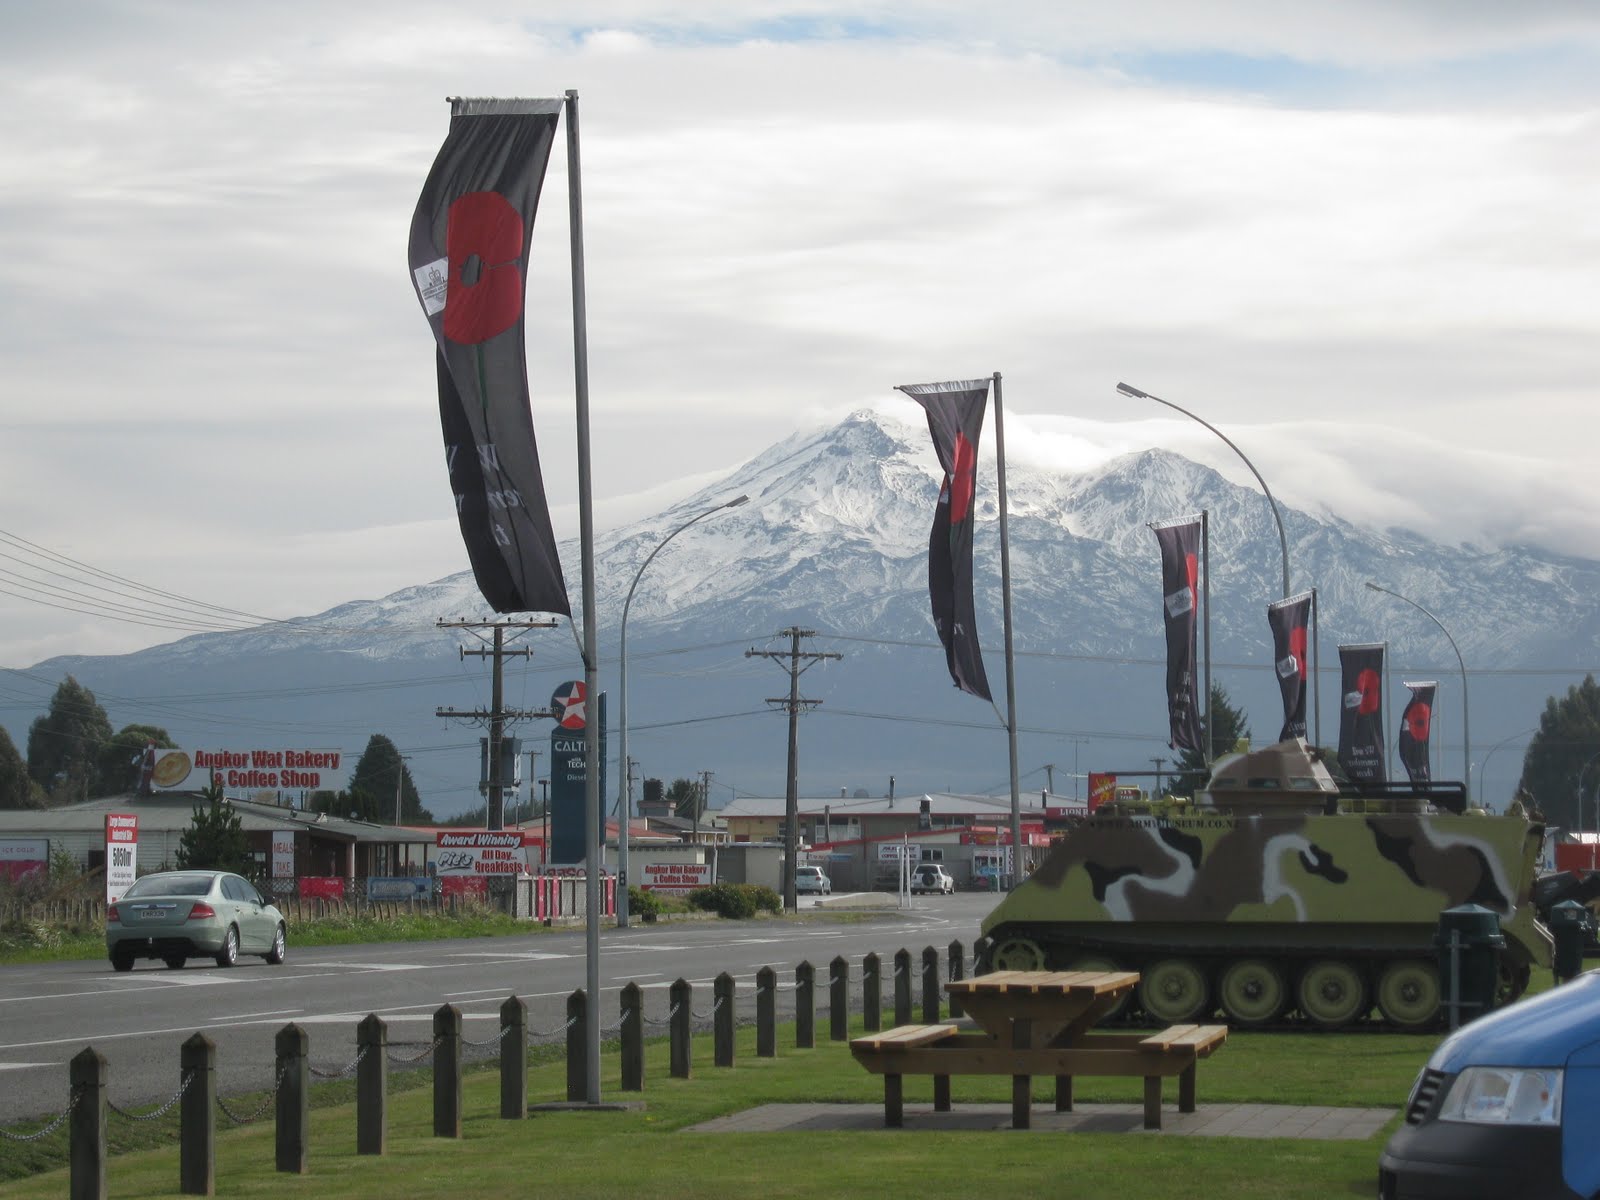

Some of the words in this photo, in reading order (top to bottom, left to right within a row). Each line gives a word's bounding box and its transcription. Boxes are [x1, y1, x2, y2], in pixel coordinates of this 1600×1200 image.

[194, 750, 249, 770] Angkor
[251, 750, 283, 768] Wat
[285, 750, 340, 770] Bakery
[214, 772, 224, 786] &
[227, 769, 279, 788] Coffee
[280, 769, 321, 789] Shop
[1060, 808, 1082, 816] LION
[440, 833, 477, 846] Award
[477, 833, 521, 850] Winning
[273, 842, 294, 854] MEALS
[438, 851, 474, 867] Pie's
[481, 849, 494, 860] All
[275, 861, 291, 873] TAKE
[475, 861, 523, 873] Breakfasts
[645, 865, 669, 875] Angkor
[669, 865, 683, 874] Wat
[684, 865, 707, 875] Bakery
[659, 875, 681, 883] Coffee
[681, 875, 699, 884] Shop
